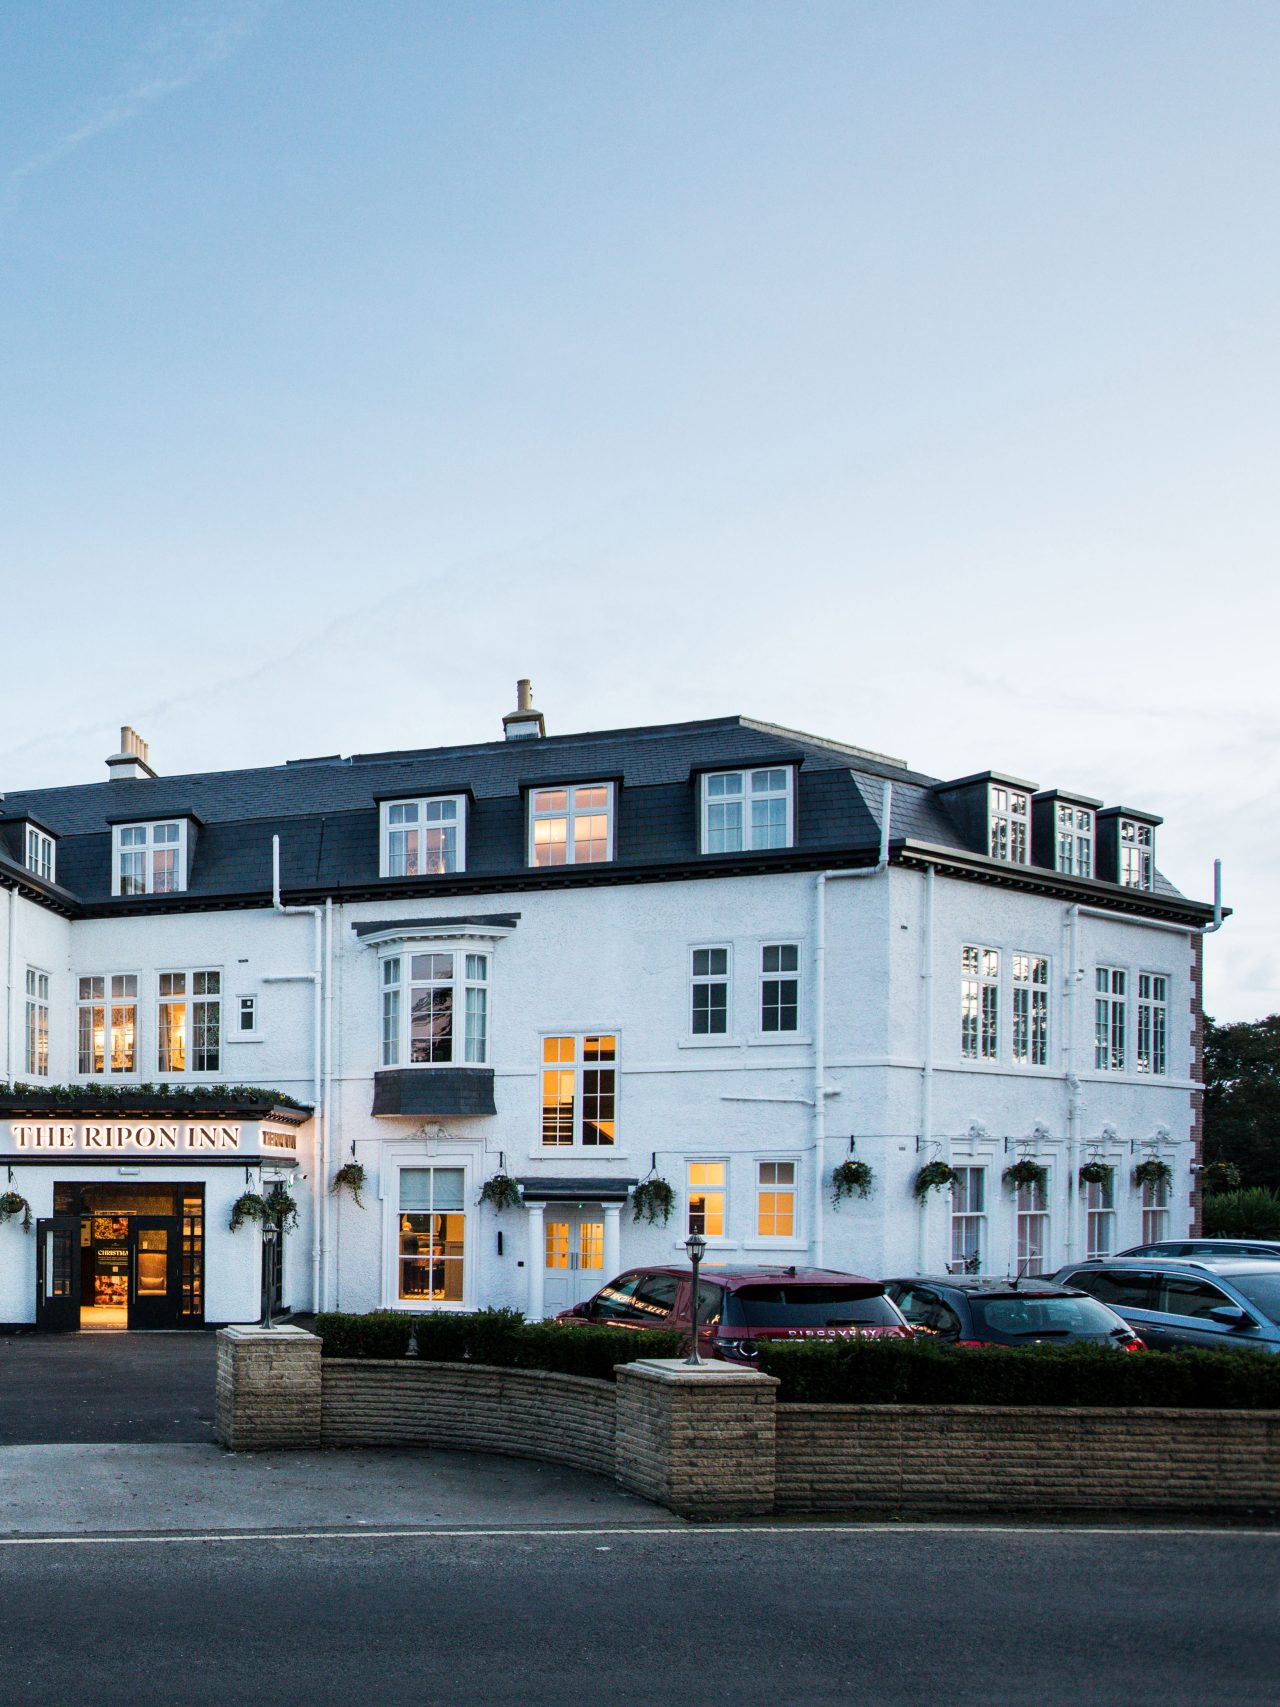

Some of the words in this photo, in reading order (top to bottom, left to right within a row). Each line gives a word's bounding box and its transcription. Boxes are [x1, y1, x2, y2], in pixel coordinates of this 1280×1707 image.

[14, 1127, 74, 1147] THE
[85, 1127, 177, 1147] RIPON
[188, 1127, 239, 1148] INN
